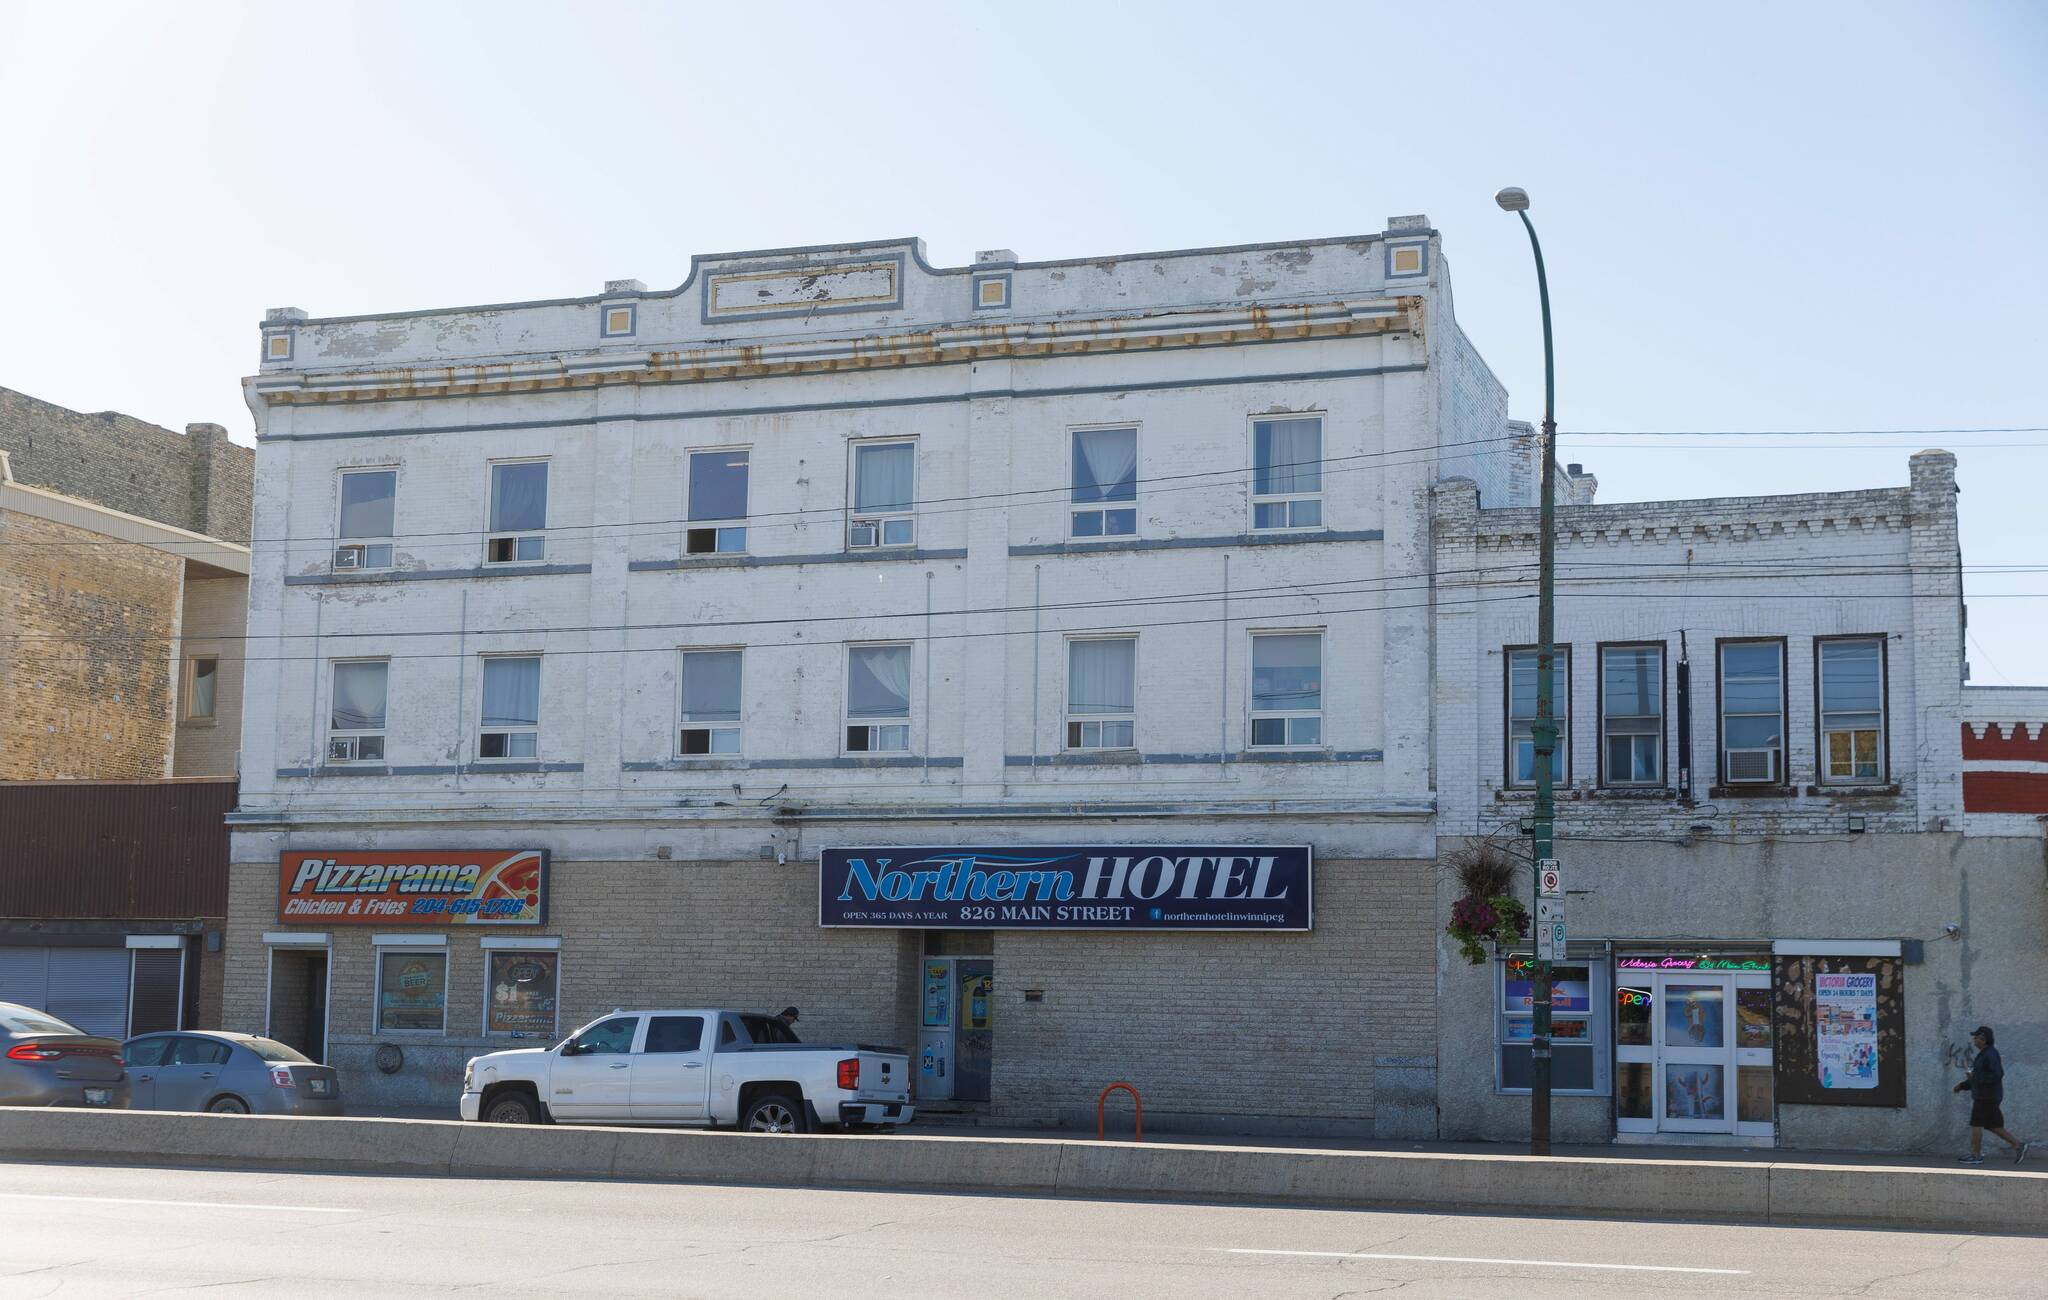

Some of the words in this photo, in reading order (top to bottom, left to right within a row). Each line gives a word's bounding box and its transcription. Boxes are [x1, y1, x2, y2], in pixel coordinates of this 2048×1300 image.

[289, 858, 481, 893] Pizzarama
[837, 856, 1076, 902] Northern
[1077, 856, 1289, 900] HOTEL
[284, 898, 347, 915] Chicken
[347, 898, 363, 915] &
[363, 898, 408, 915] Fries
[410, 898, 526, 915] 204-615-1786
[843, 911, 868, 920] OPEN
[870, 911, 887, 920] 365
[889, 911, 913, 920] DAYS
[914, 912, 922, 920] A
[923, 911, 948, 920] YEAR
[960, 906, 996, 920] 826
[1001, 906, 1051, 920] MAIN
[1056, 906, 1136, 921] STREET
[1163, 911, 1285, 923] northernhotelinwinnipeg
[1661, 957, 1695, 969] Grocery
[511, 967, 538, 978] OPEN
[405, 977, 426, 987] BEER
[1819, 976, 1846, 988] VICTORIA
[1846, 976, 1874, 988] GROCERY
[1617, 991, 1651, 1006] Open
[1818, 989, 1832, 997] OPEN
[1860, 989, 1874, 997] DAYS
